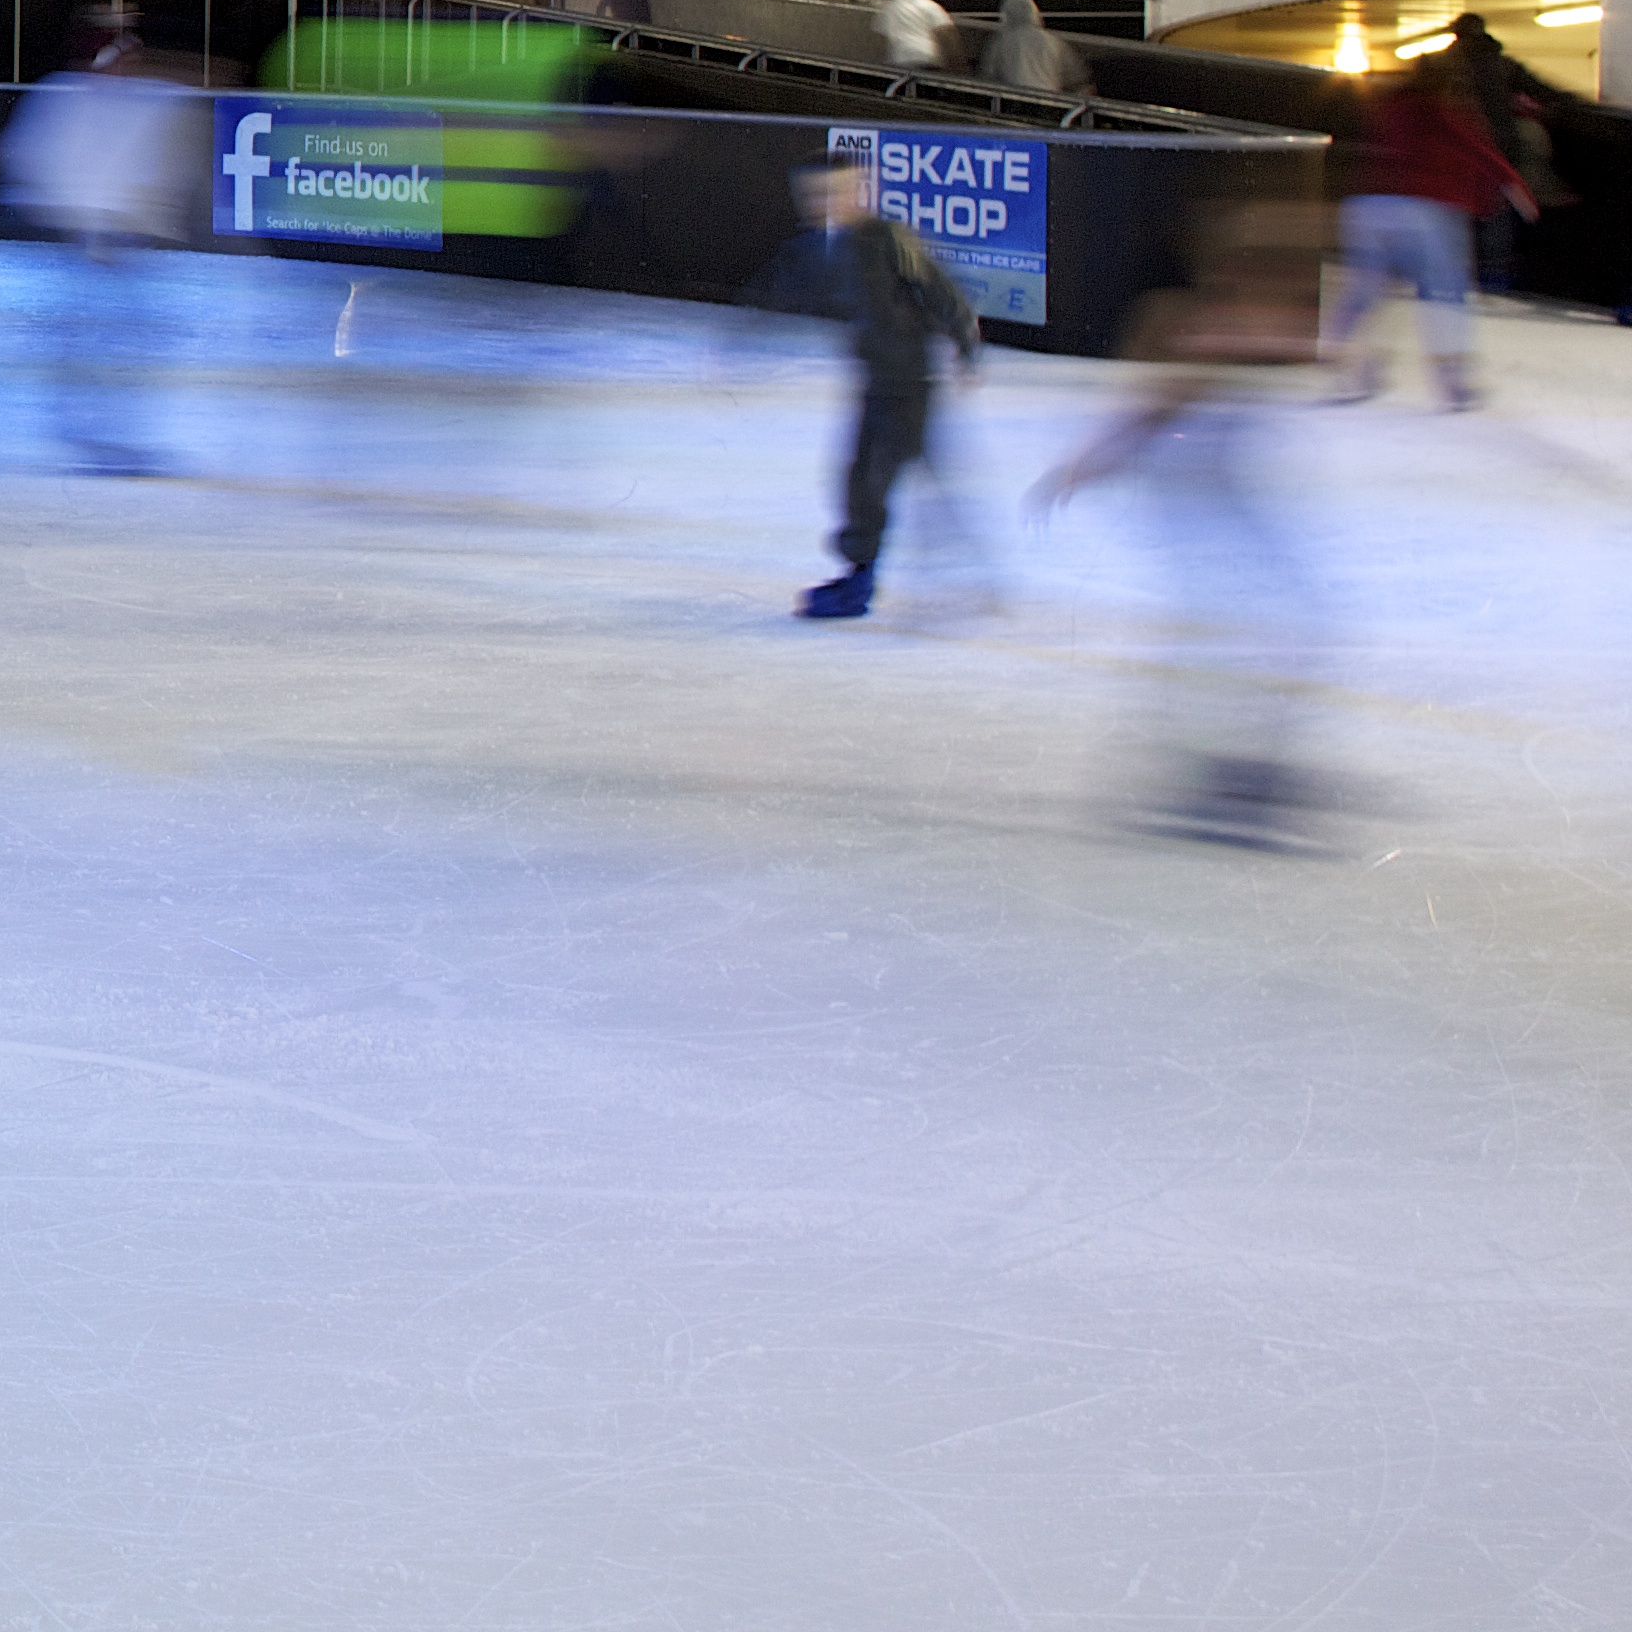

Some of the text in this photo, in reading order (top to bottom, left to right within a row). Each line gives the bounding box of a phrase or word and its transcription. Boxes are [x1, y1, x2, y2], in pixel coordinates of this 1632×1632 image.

[304, 134, 388, 157] Find us on
[836, 134, 872, 150] AND
[223, 112, 272, 231] f
[284, 156, 430, 204] facebook
[881, 142, 1030, 193] SKATE
[266, 216, 301, 230] Search
[303, 218, 318, 231] for
[344, 222, 368, 238] Caps
[880, 189, 1007, 239] SHOP
[970, 253, 991, 266] THE
